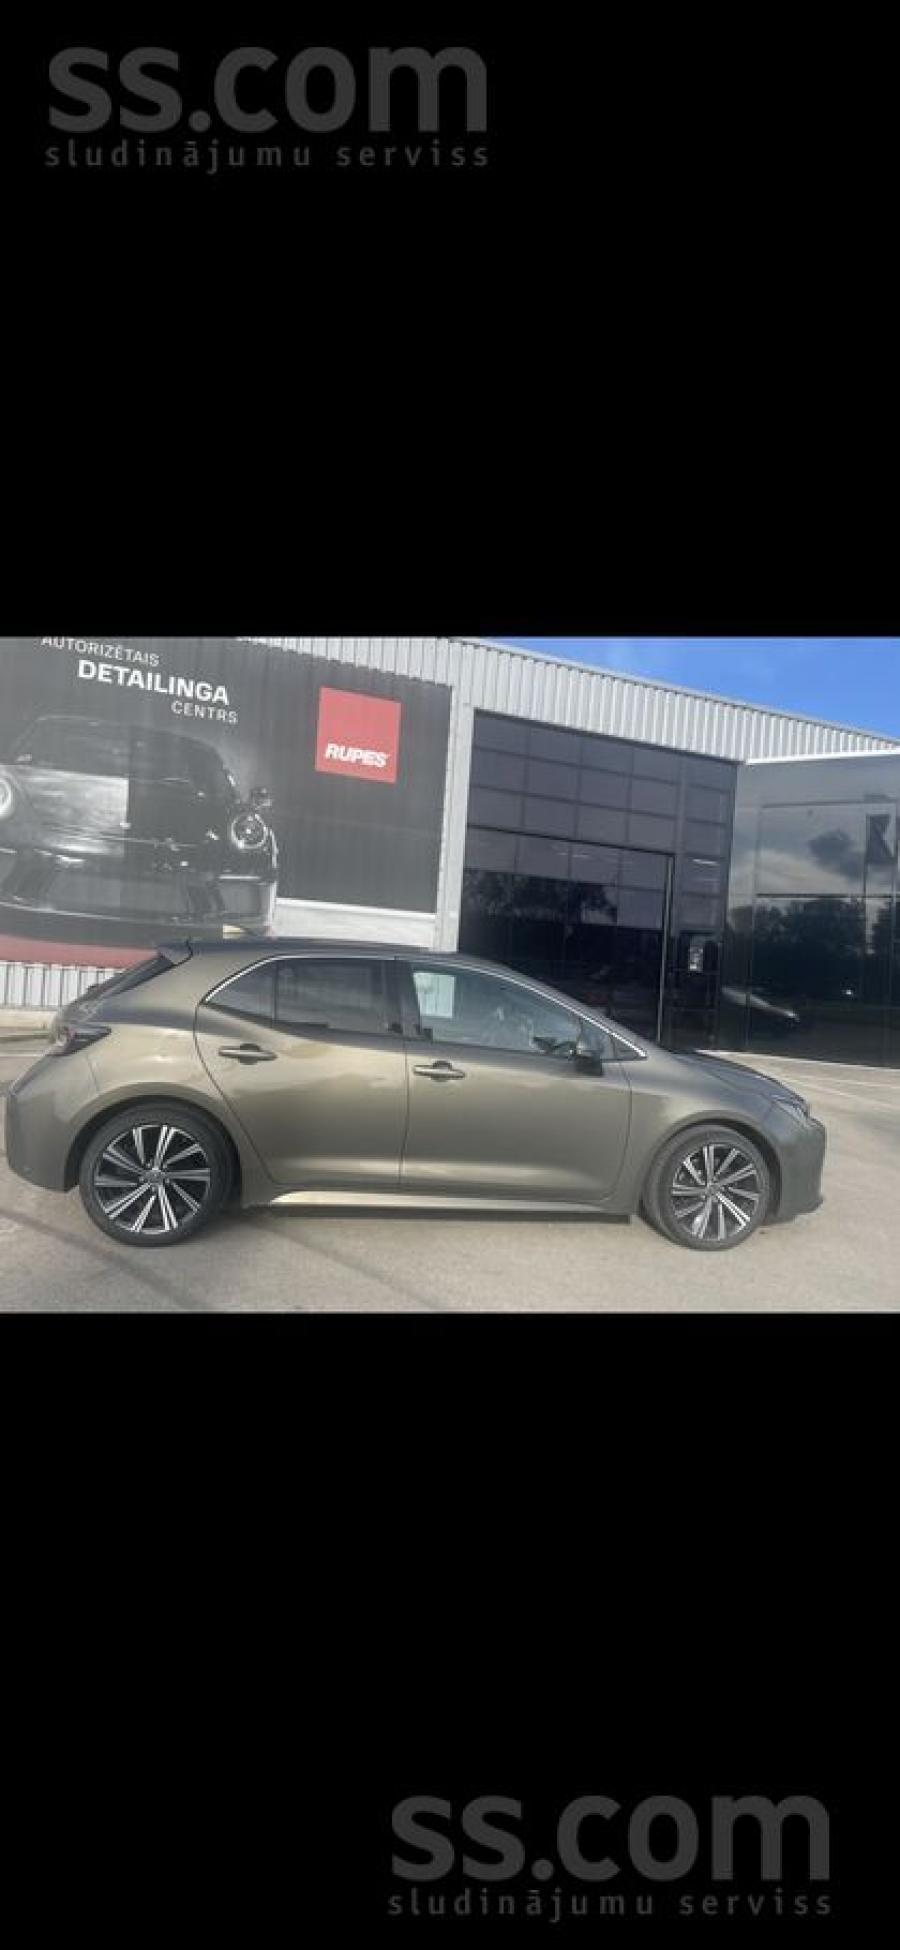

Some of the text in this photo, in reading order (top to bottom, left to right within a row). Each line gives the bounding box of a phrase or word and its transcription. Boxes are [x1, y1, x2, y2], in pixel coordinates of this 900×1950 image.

[77, 659, 230, 706] DETAILINGA
[171, 700, 239, 725] CENTRS
[325, 743, 388, 768] RUPES
